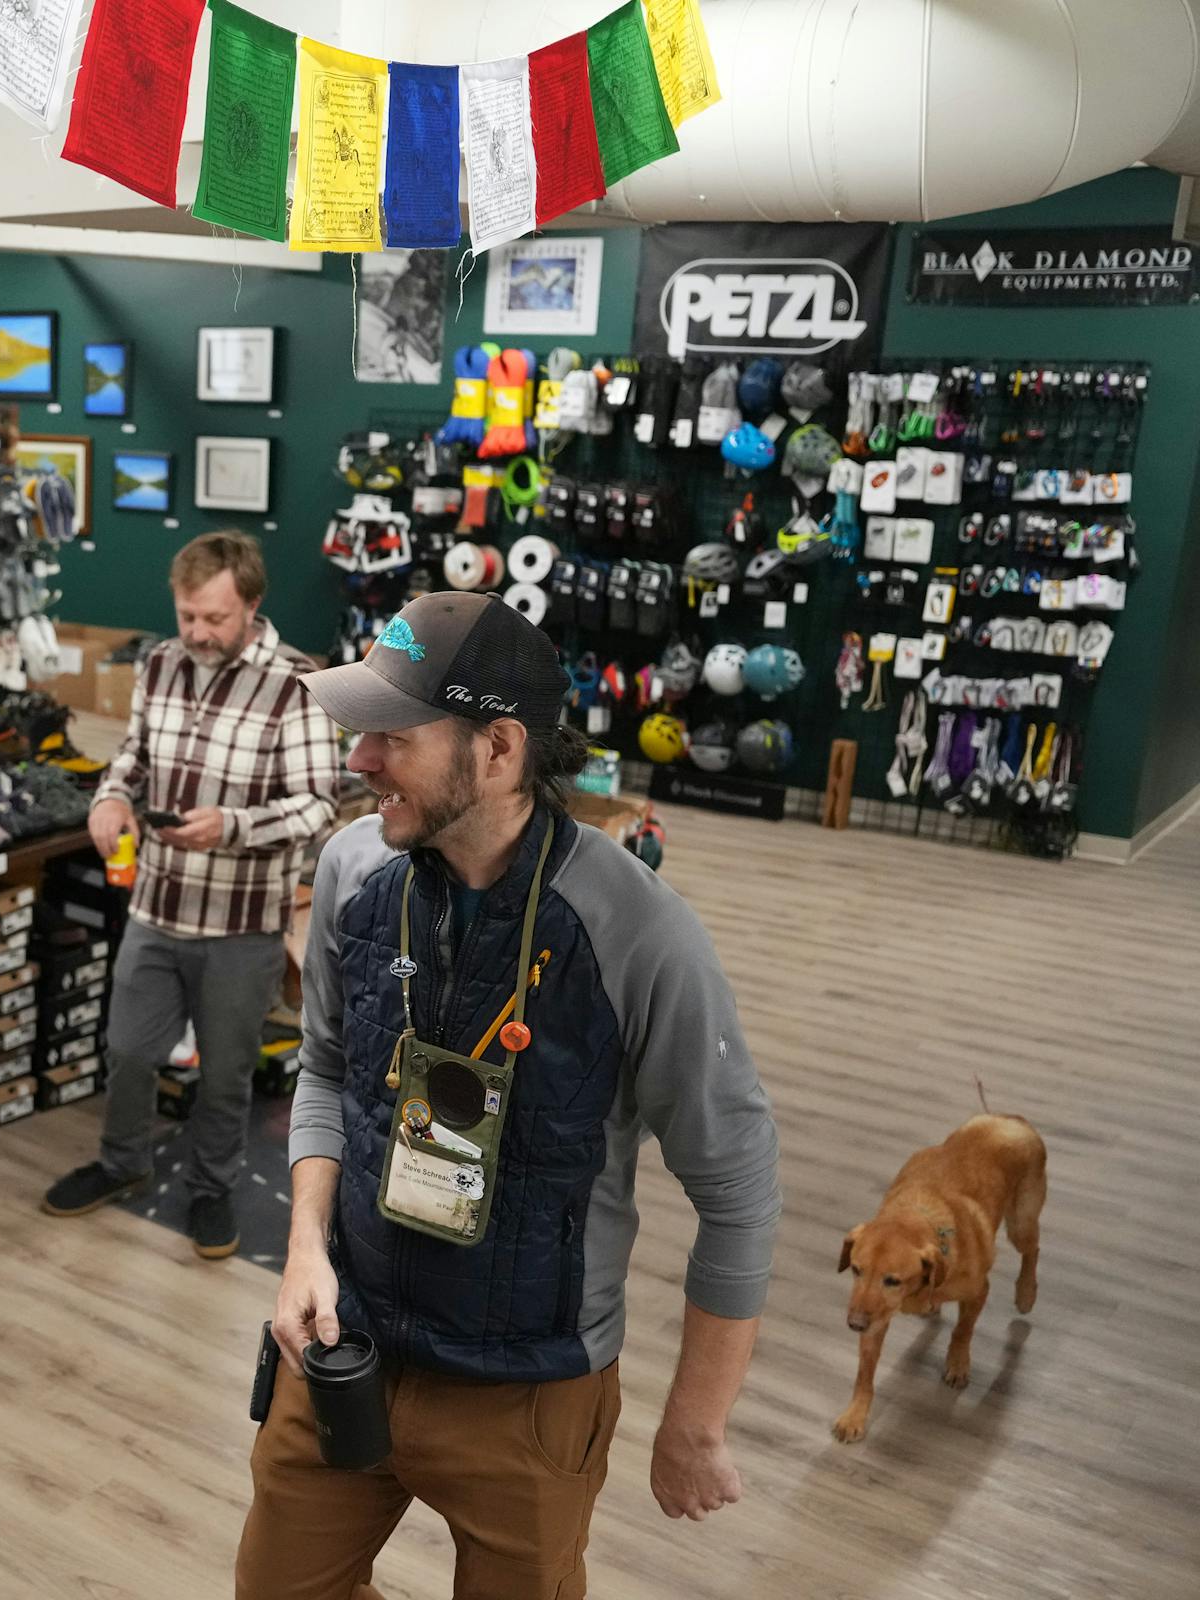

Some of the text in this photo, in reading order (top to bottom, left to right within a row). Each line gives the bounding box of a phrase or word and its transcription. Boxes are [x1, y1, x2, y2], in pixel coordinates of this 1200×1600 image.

[1035, 247, 1192, 270] DIAMOND
[668, 274, 867, 360] PETZL
[446, 685, 518, 713] The Toad
[402, 1162, 421, 1174] Steve
